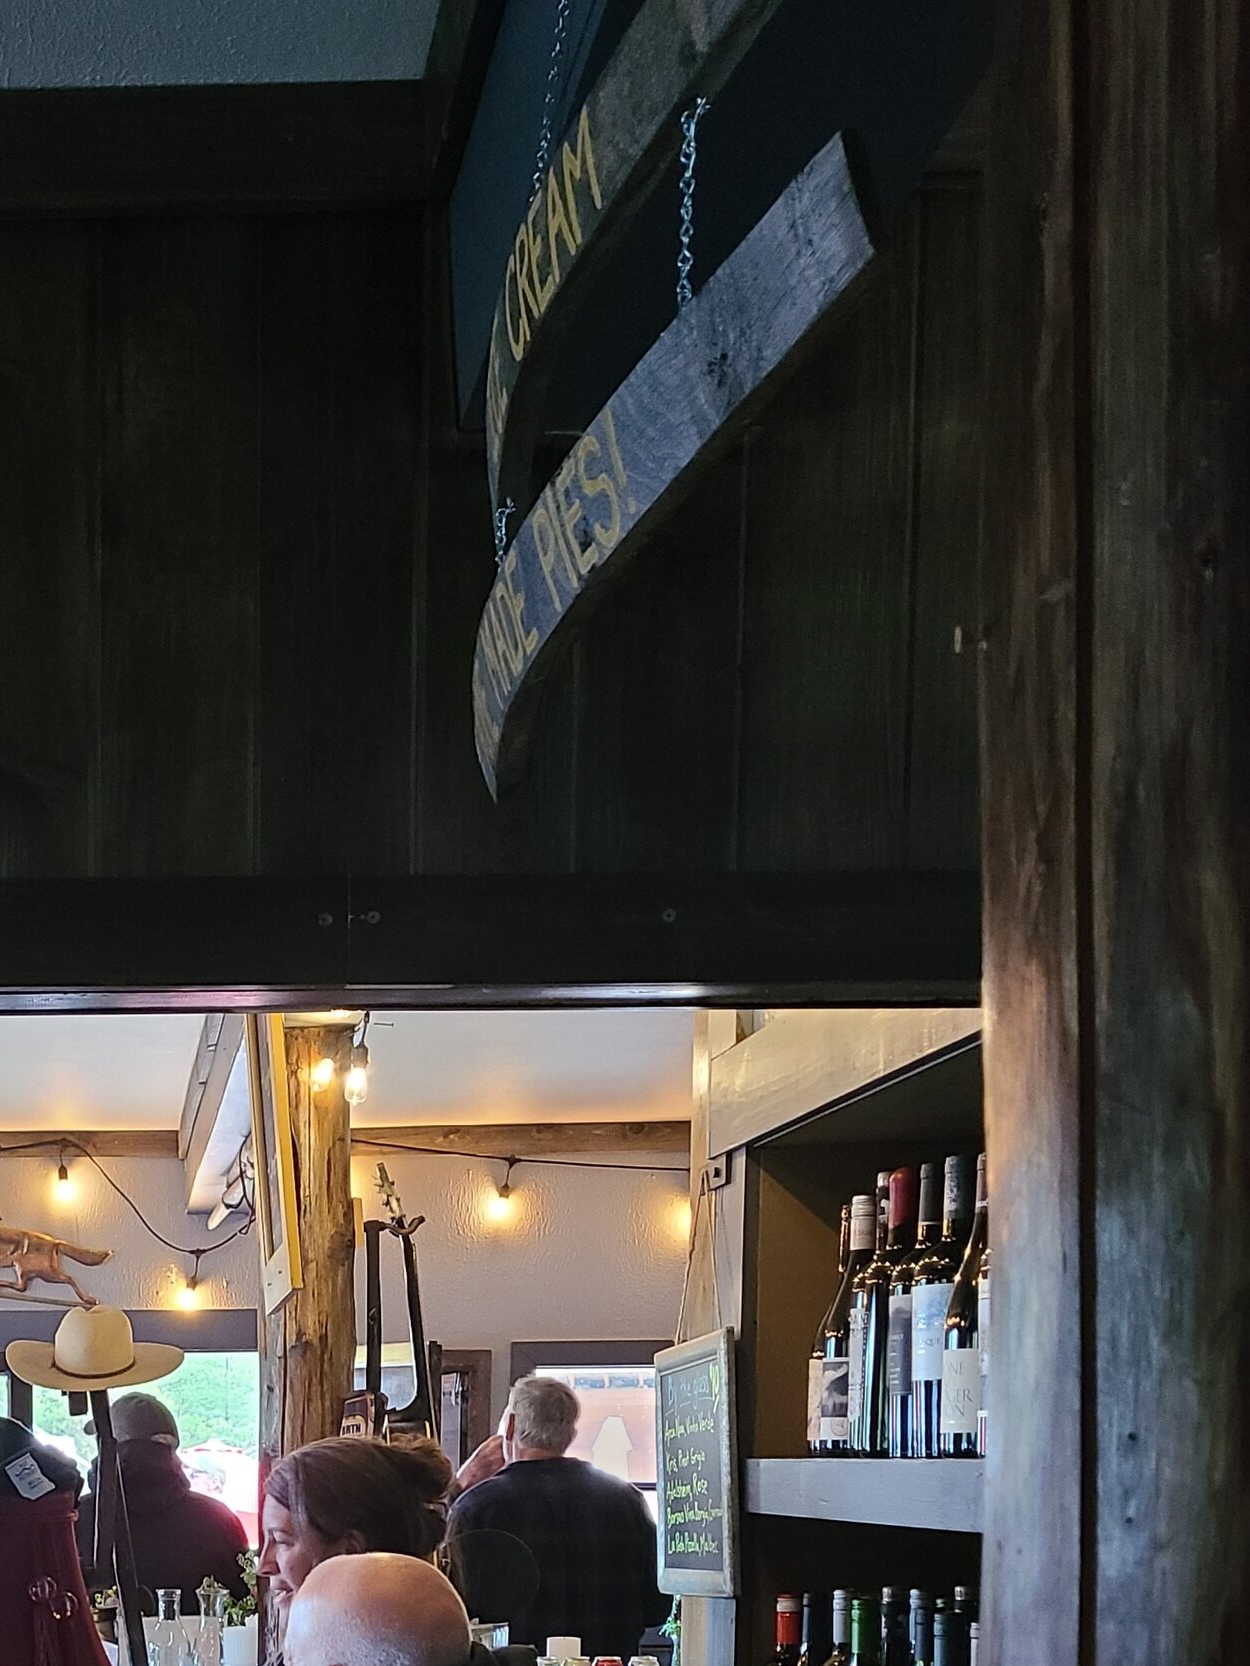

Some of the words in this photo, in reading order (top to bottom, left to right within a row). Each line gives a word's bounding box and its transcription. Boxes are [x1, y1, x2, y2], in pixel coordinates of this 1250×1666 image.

[504, 103, 602, 362] CREAM
[479, 550, 539, 711] MADE
[532, 407, 637, 613] PIES!
